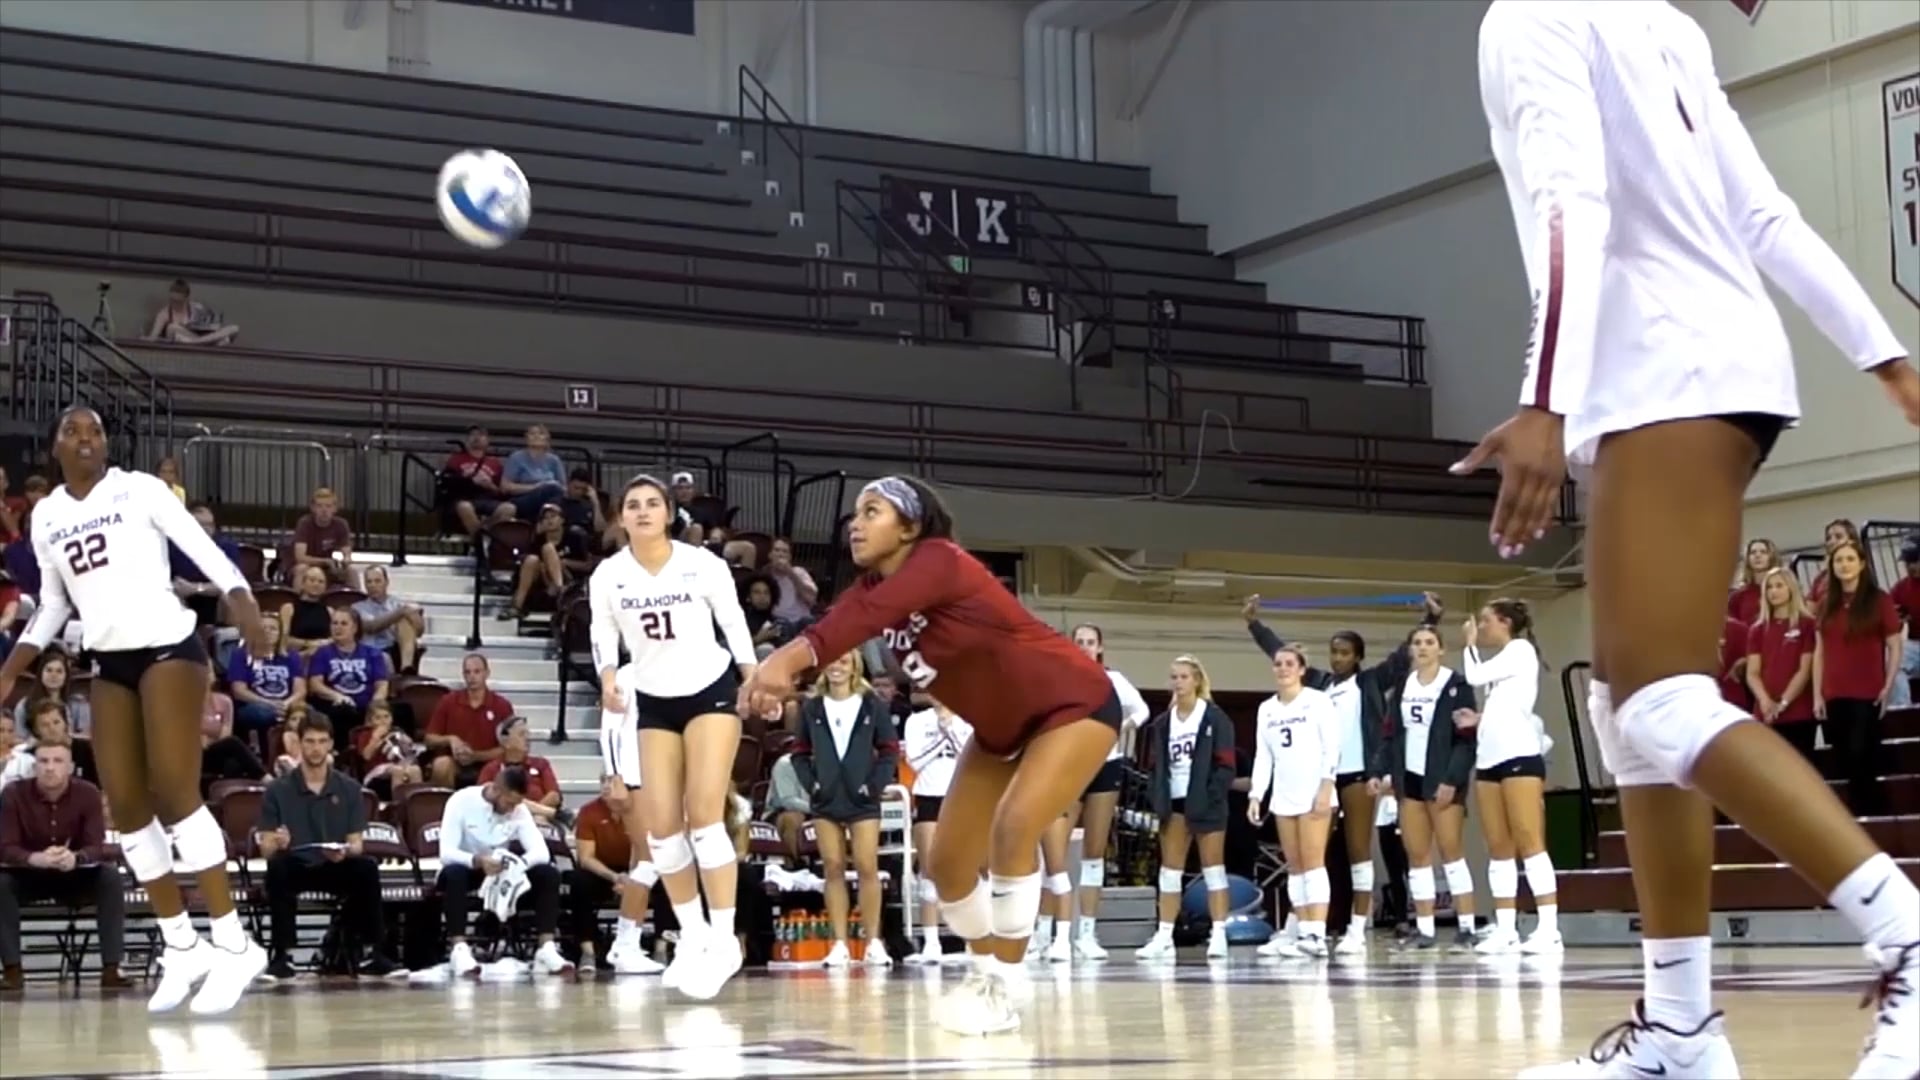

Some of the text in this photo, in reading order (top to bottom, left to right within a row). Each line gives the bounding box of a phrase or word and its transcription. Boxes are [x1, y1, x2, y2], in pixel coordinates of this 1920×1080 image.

[907, 191, 1009, 245] J K
[573, 389, 589, 404] 13
[49, 513, 123, 545] OKLAHOMA
[64, 533, 109, 576] 22
[620, 592, 693, 610] OKLAHOMA
[640, 610, 676, 641] 21
[1279, 727, 1292, 748] 3
